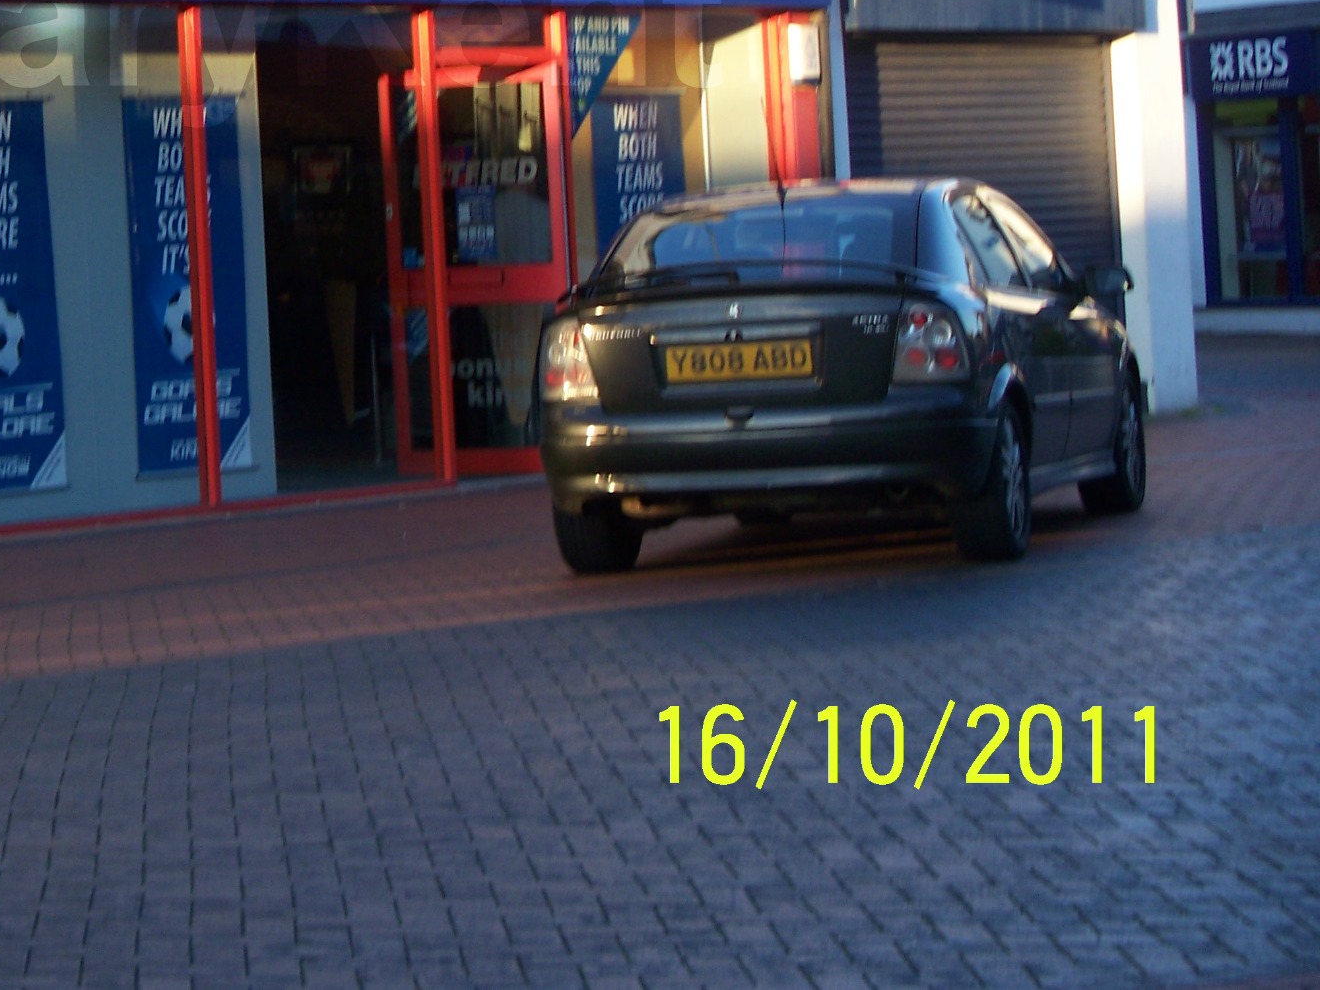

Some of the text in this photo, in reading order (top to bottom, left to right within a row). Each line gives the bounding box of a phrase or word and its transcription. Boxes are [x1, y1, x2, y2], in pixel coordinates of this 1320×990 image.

[1237, 36, 1289, 79] RBS
[613, 100, 658, 132] WHEN
[157, 140, 184, 173] BO
[618, 131, 657, 162] BOTH
[616, 160, 663, 193] TEAMS
